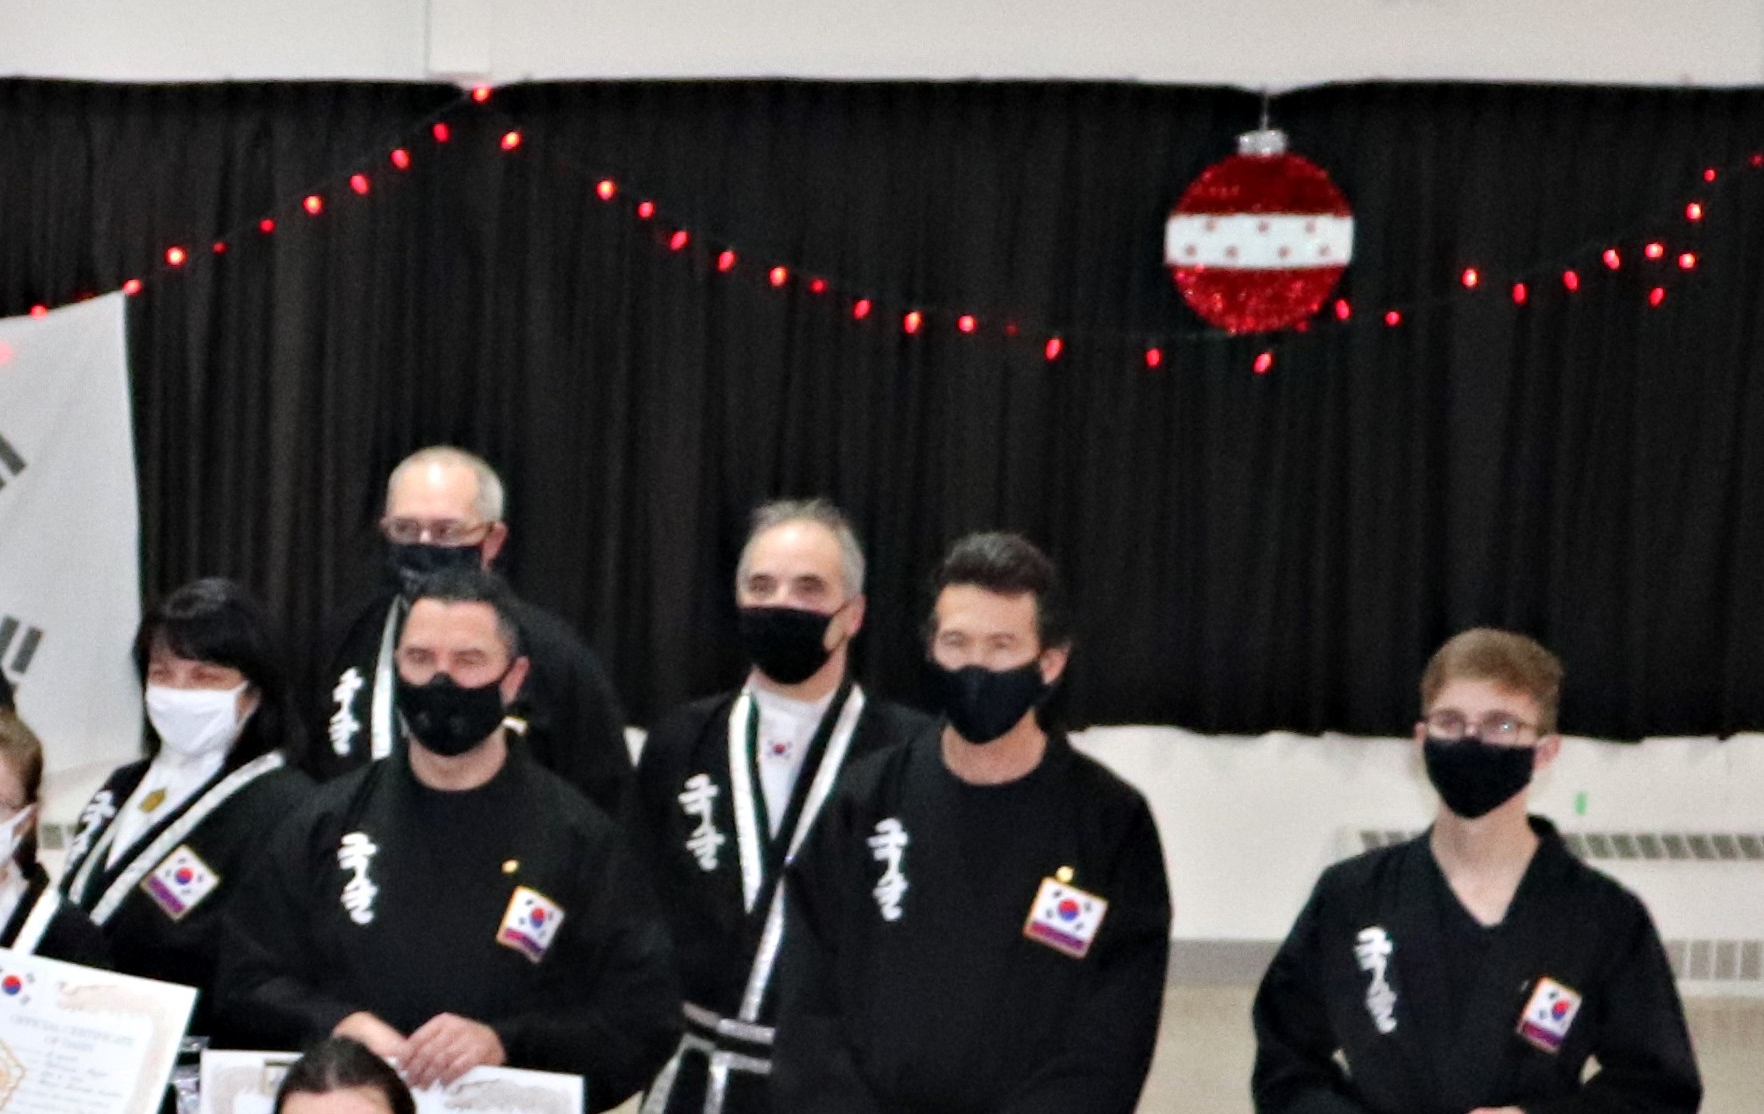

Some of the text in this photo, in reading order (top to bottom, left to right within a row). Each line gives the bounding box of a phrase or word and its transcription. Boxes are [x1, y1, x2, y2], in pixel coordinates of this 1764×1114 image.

[679, 774, 725, 870] 국술
[869, 818, 908, 921] 국술
[338, 832, 378, 924] 국술
